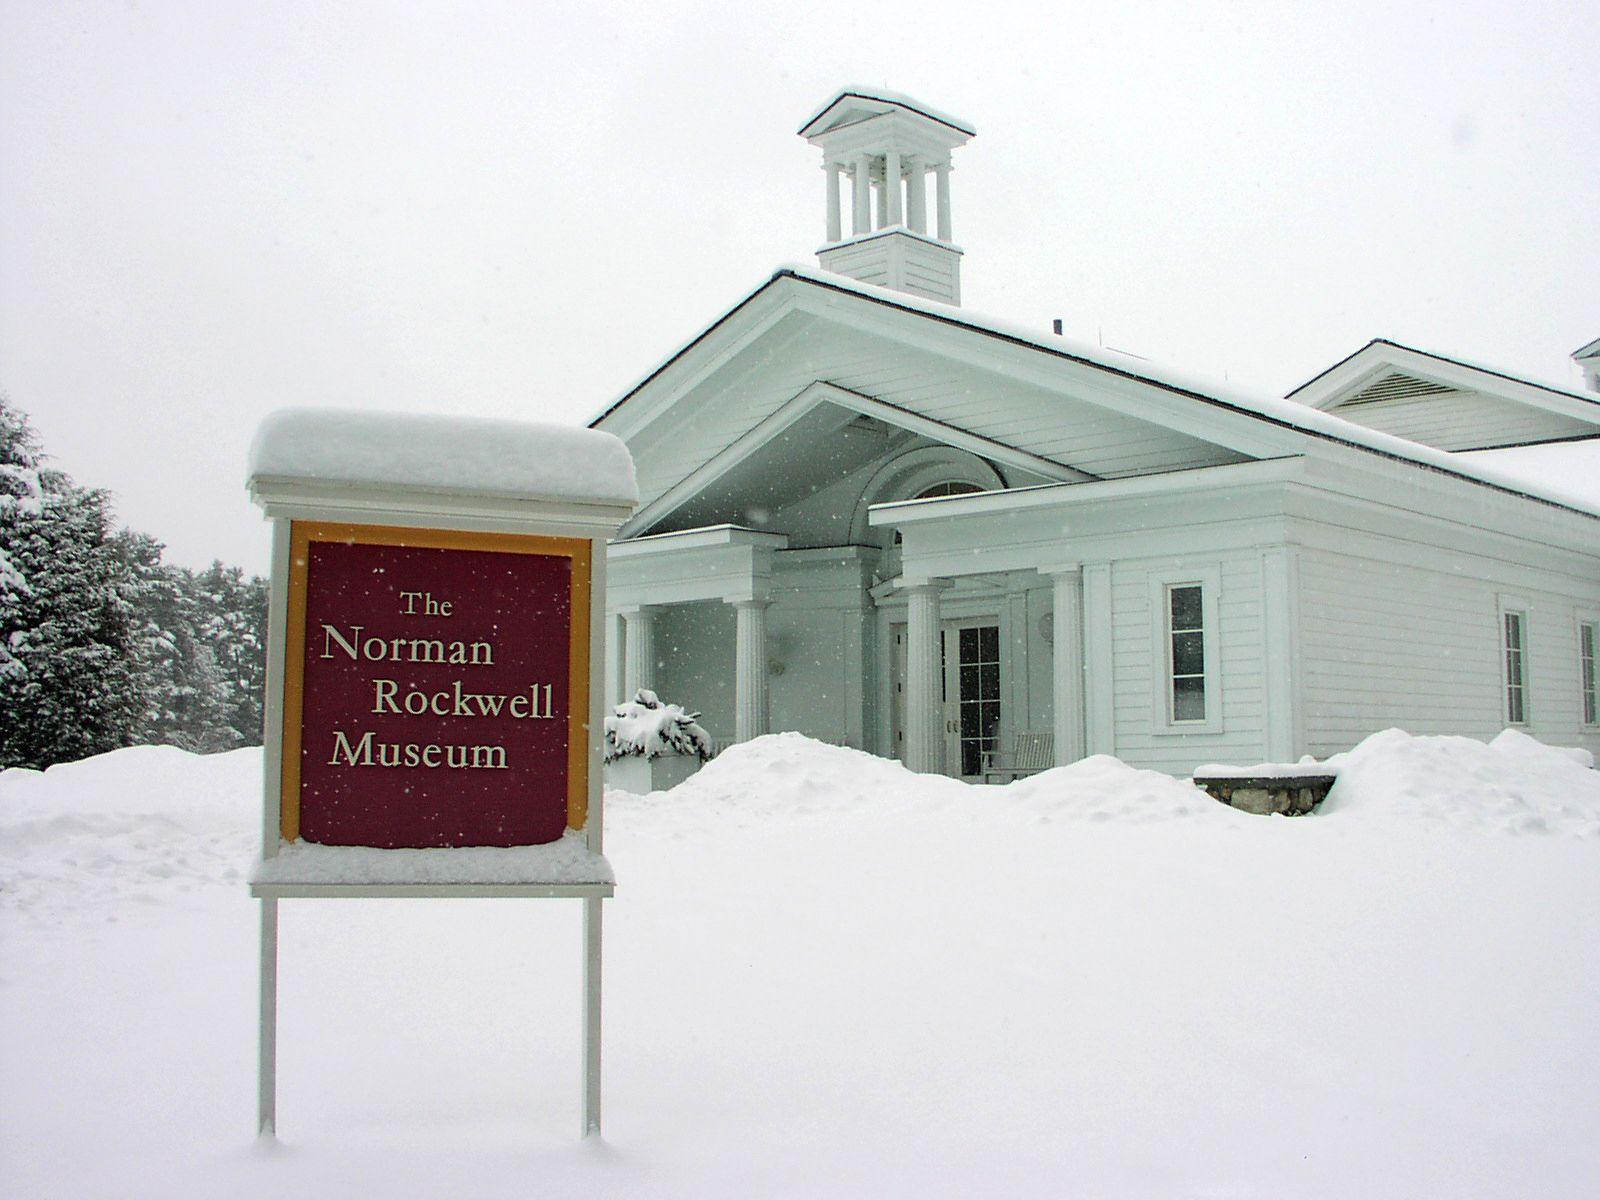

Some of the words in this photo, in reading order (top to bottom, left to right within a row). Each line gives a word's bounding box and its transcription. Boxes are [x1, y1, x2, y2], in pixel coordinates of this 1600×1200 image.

[400, 591, 453, 616] The
[320, 624, 494, 665] Norman
[372, 679, 554, 719] Rockwell
[327, 731, 508, 768] Museum
